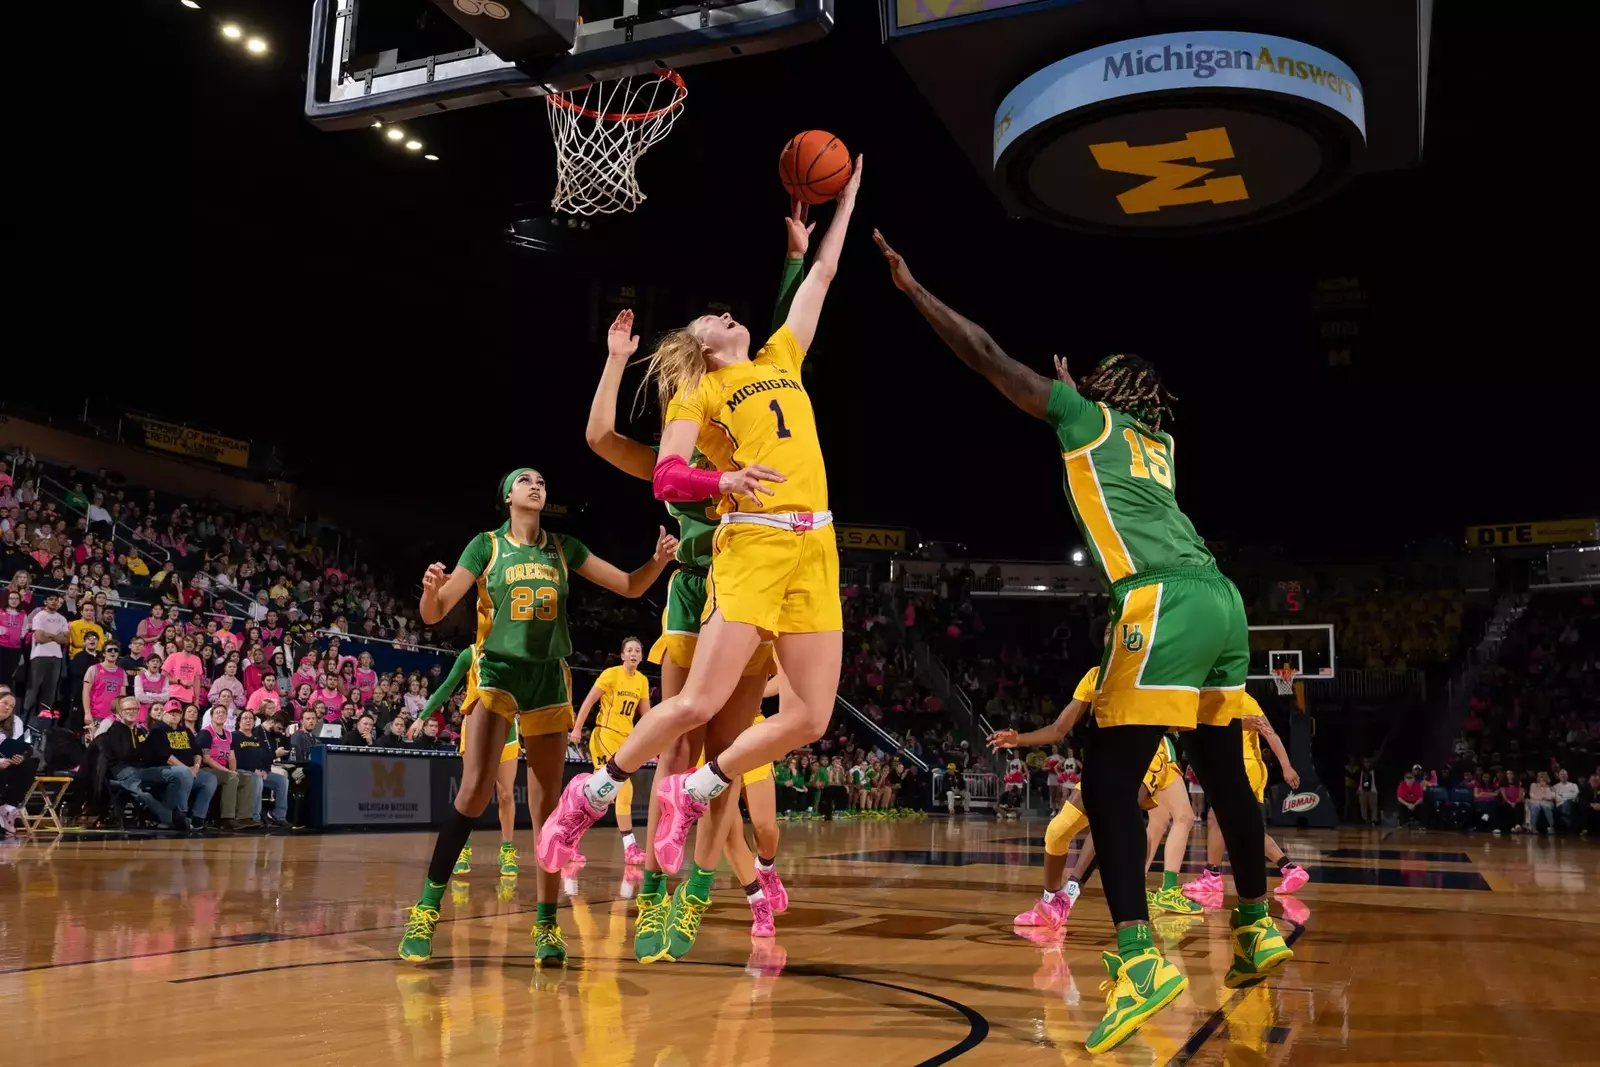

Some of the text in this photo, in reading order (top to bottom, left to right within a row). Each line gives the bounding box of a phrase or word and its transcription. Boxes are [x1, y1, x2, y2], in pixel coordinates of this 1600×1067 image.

[1088, 126, 1250, 214] M
[726, 378, 802, 412] MICHIGAN
[769, 399, 792, 439] 1
[185, 430, 200, 441] OF
[201, 435, 249, 452] MICHIGAN
[1122, 428, 1172, 490] 15
[1478, 525, 1532, 545] DTE
[511, 586, 558, 620] 23
[1286, 592, 1300, 613] 5
[620, 700, 635, 716] 10
[372, 760, 405, 798] M
[1284, 796, 1315, 810] LIBMAN
